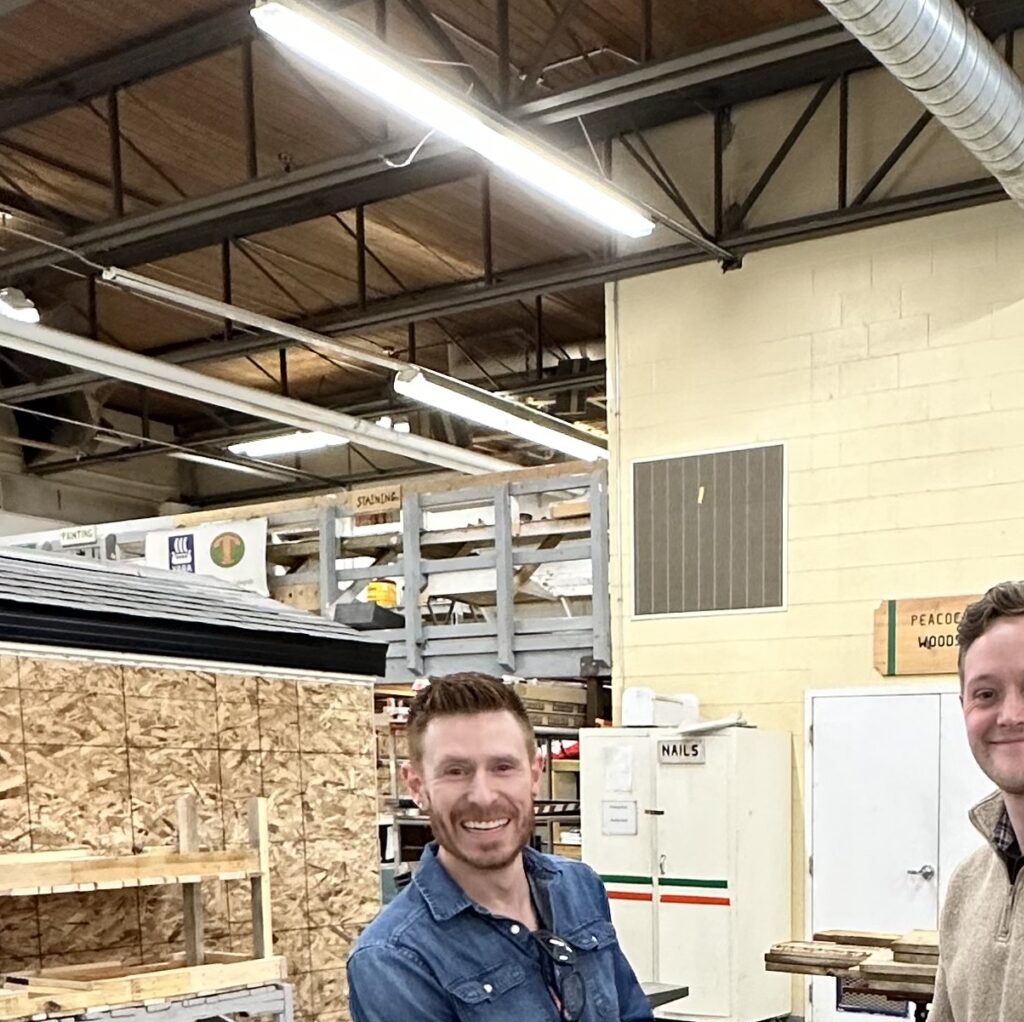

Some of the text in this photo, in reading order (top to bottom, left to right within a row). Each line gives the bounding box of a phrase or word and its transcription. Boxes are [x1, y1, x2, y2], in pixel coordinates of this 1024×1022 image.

[356, 491, 400, 508] STAINING
[910, 612, 961, 626] PEACOC
[661, 744, 699, 757] NAILS
